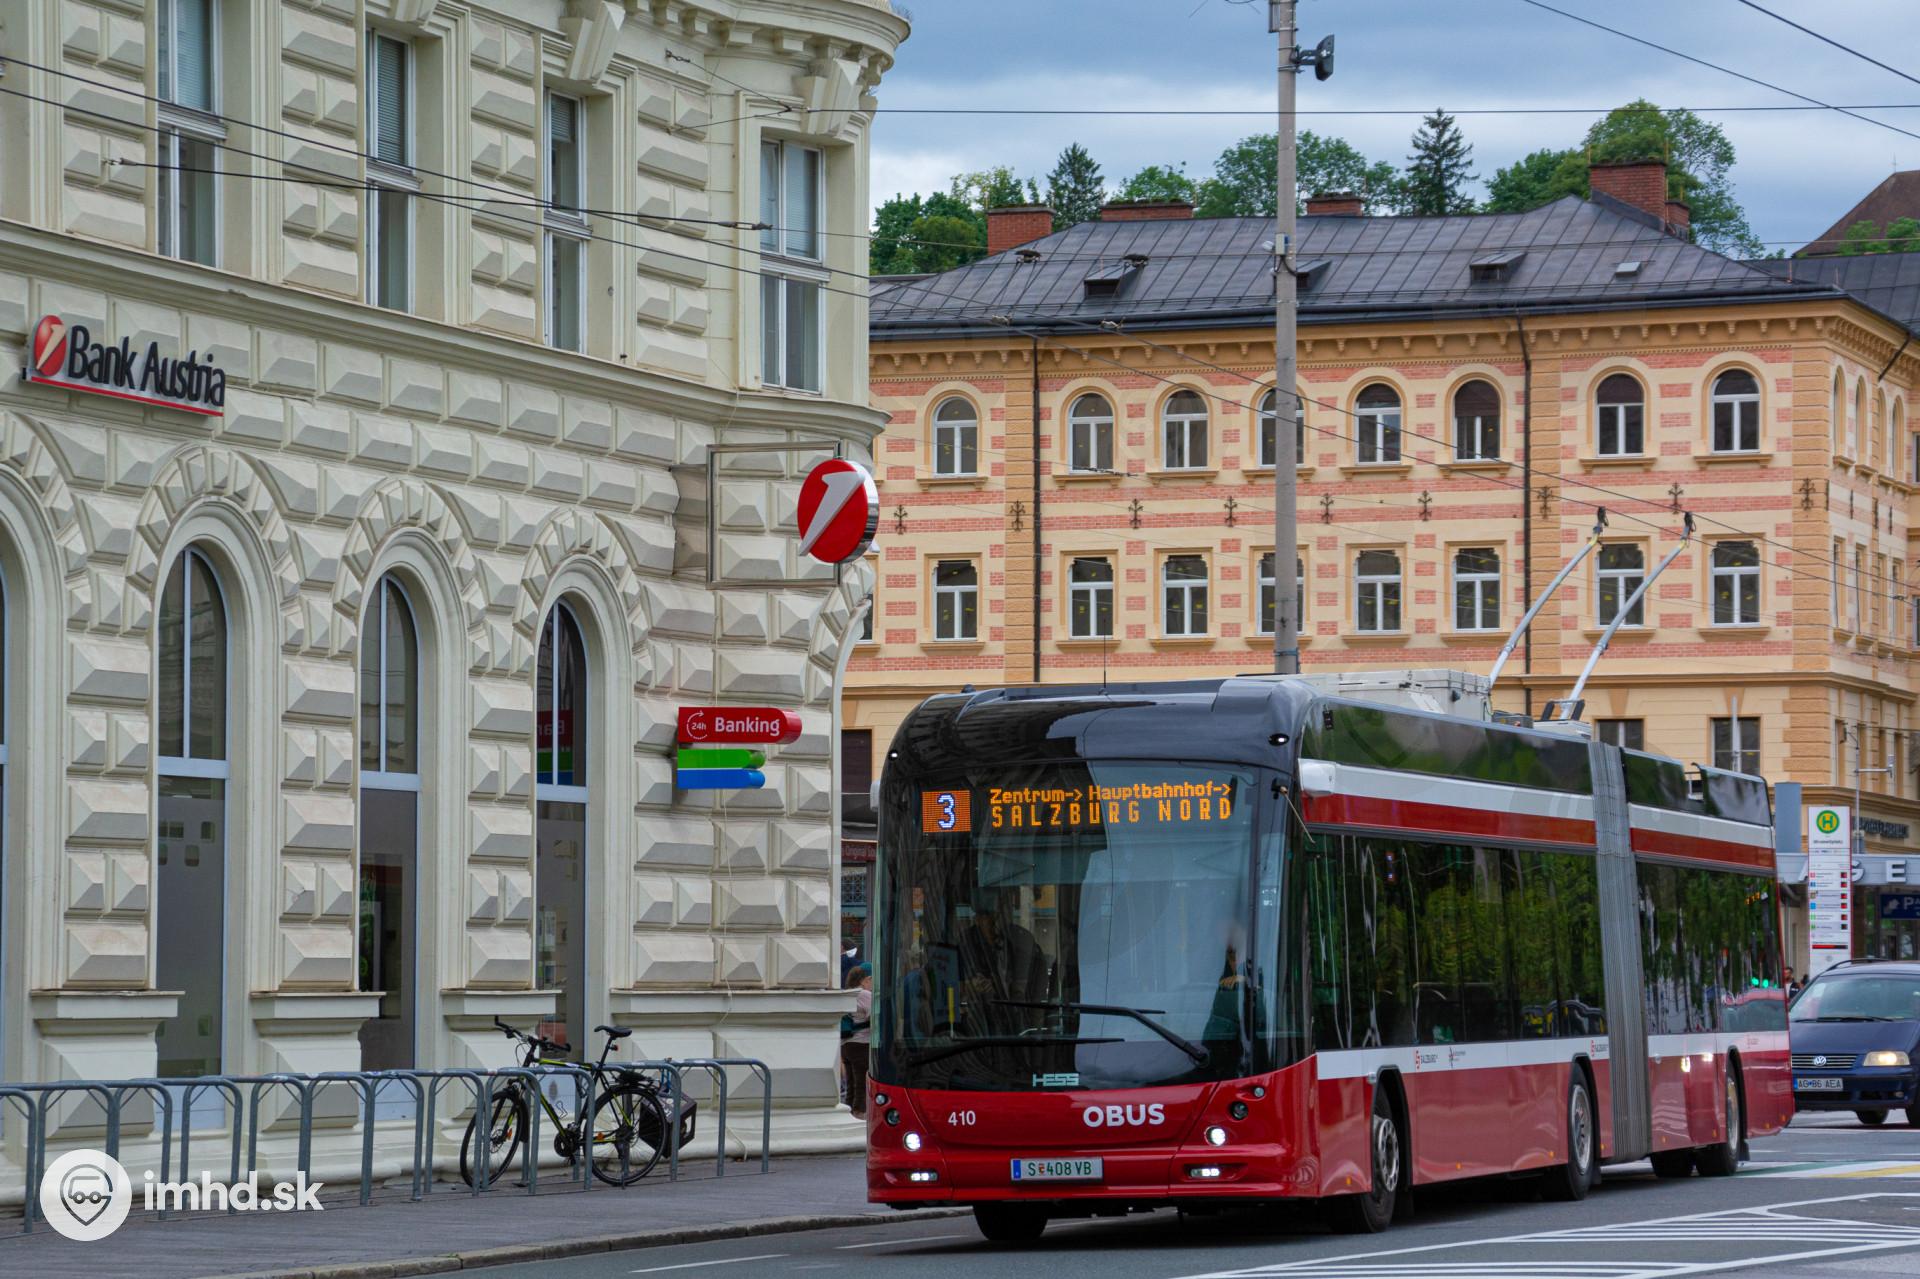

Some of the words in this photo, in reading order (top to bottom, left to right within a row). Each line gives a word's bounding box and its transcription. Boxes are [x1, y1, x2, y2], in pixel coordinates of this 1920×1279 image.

[68, 325, 137, 390] Bank
[140, 341, 225, 407] Austria
[691, 722, 707, 731] 24h
[715, 717, 780, 736] Banking
[938, 793, 956, 829] 3
[991, 800, 1139, 828] SALZBURG
[1158, 797, 1231, 821] NORD
[1822, 815, 1834, 829] H
[1033, 1073, 1079, 1087] HESS
[948, 1110, 976, 1126] 410
[1083, 1104, 1165, 1127] OBUS
[1028, 1162, 1036, 1176] S
[1046, 1161, 1072, 1176] 408
[1075, 1161, 1092, 1175] VB
